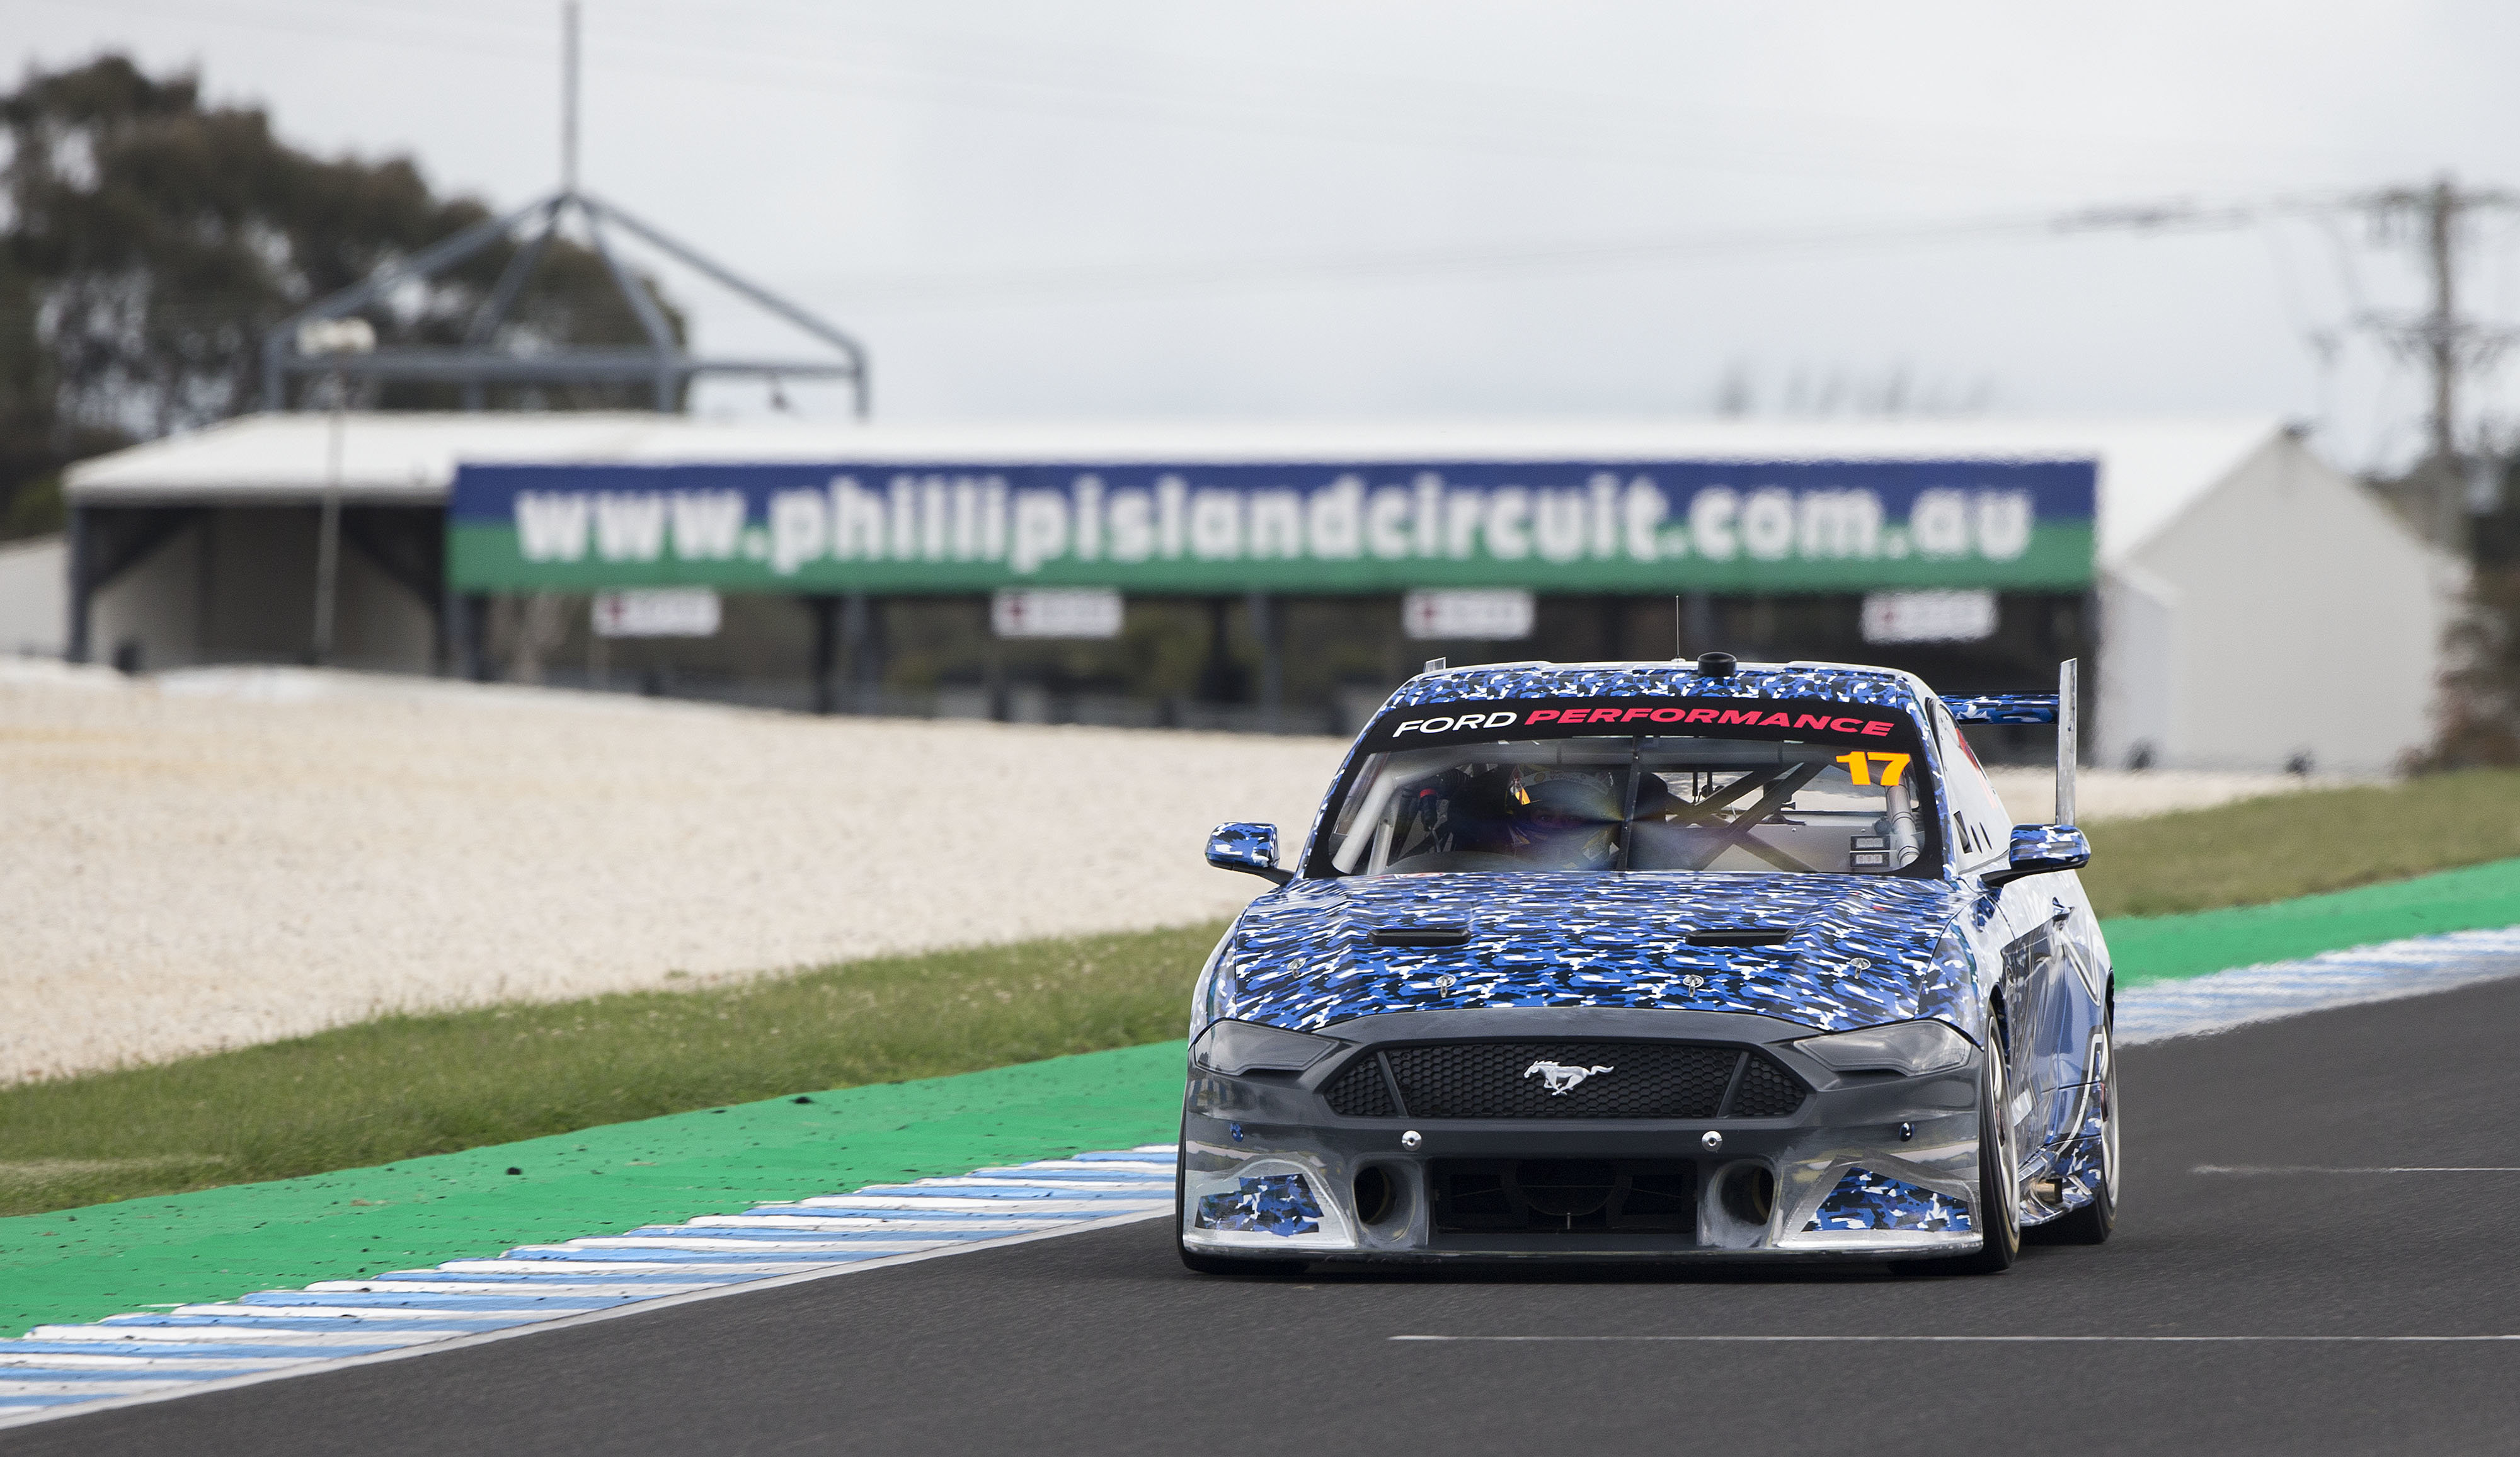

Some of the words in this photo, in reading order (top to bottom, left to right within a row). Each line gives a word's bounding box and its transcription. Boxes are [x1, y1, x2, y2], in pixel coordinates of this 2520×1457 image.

[518, 476, 2030, 573] www.phillipislandcircuit.com.au
[1392, 712, 1518, 738] FORD
[1524, 708, 1894, 736] PERFORMANCE
[1835, 751, 1911, 787] 17
